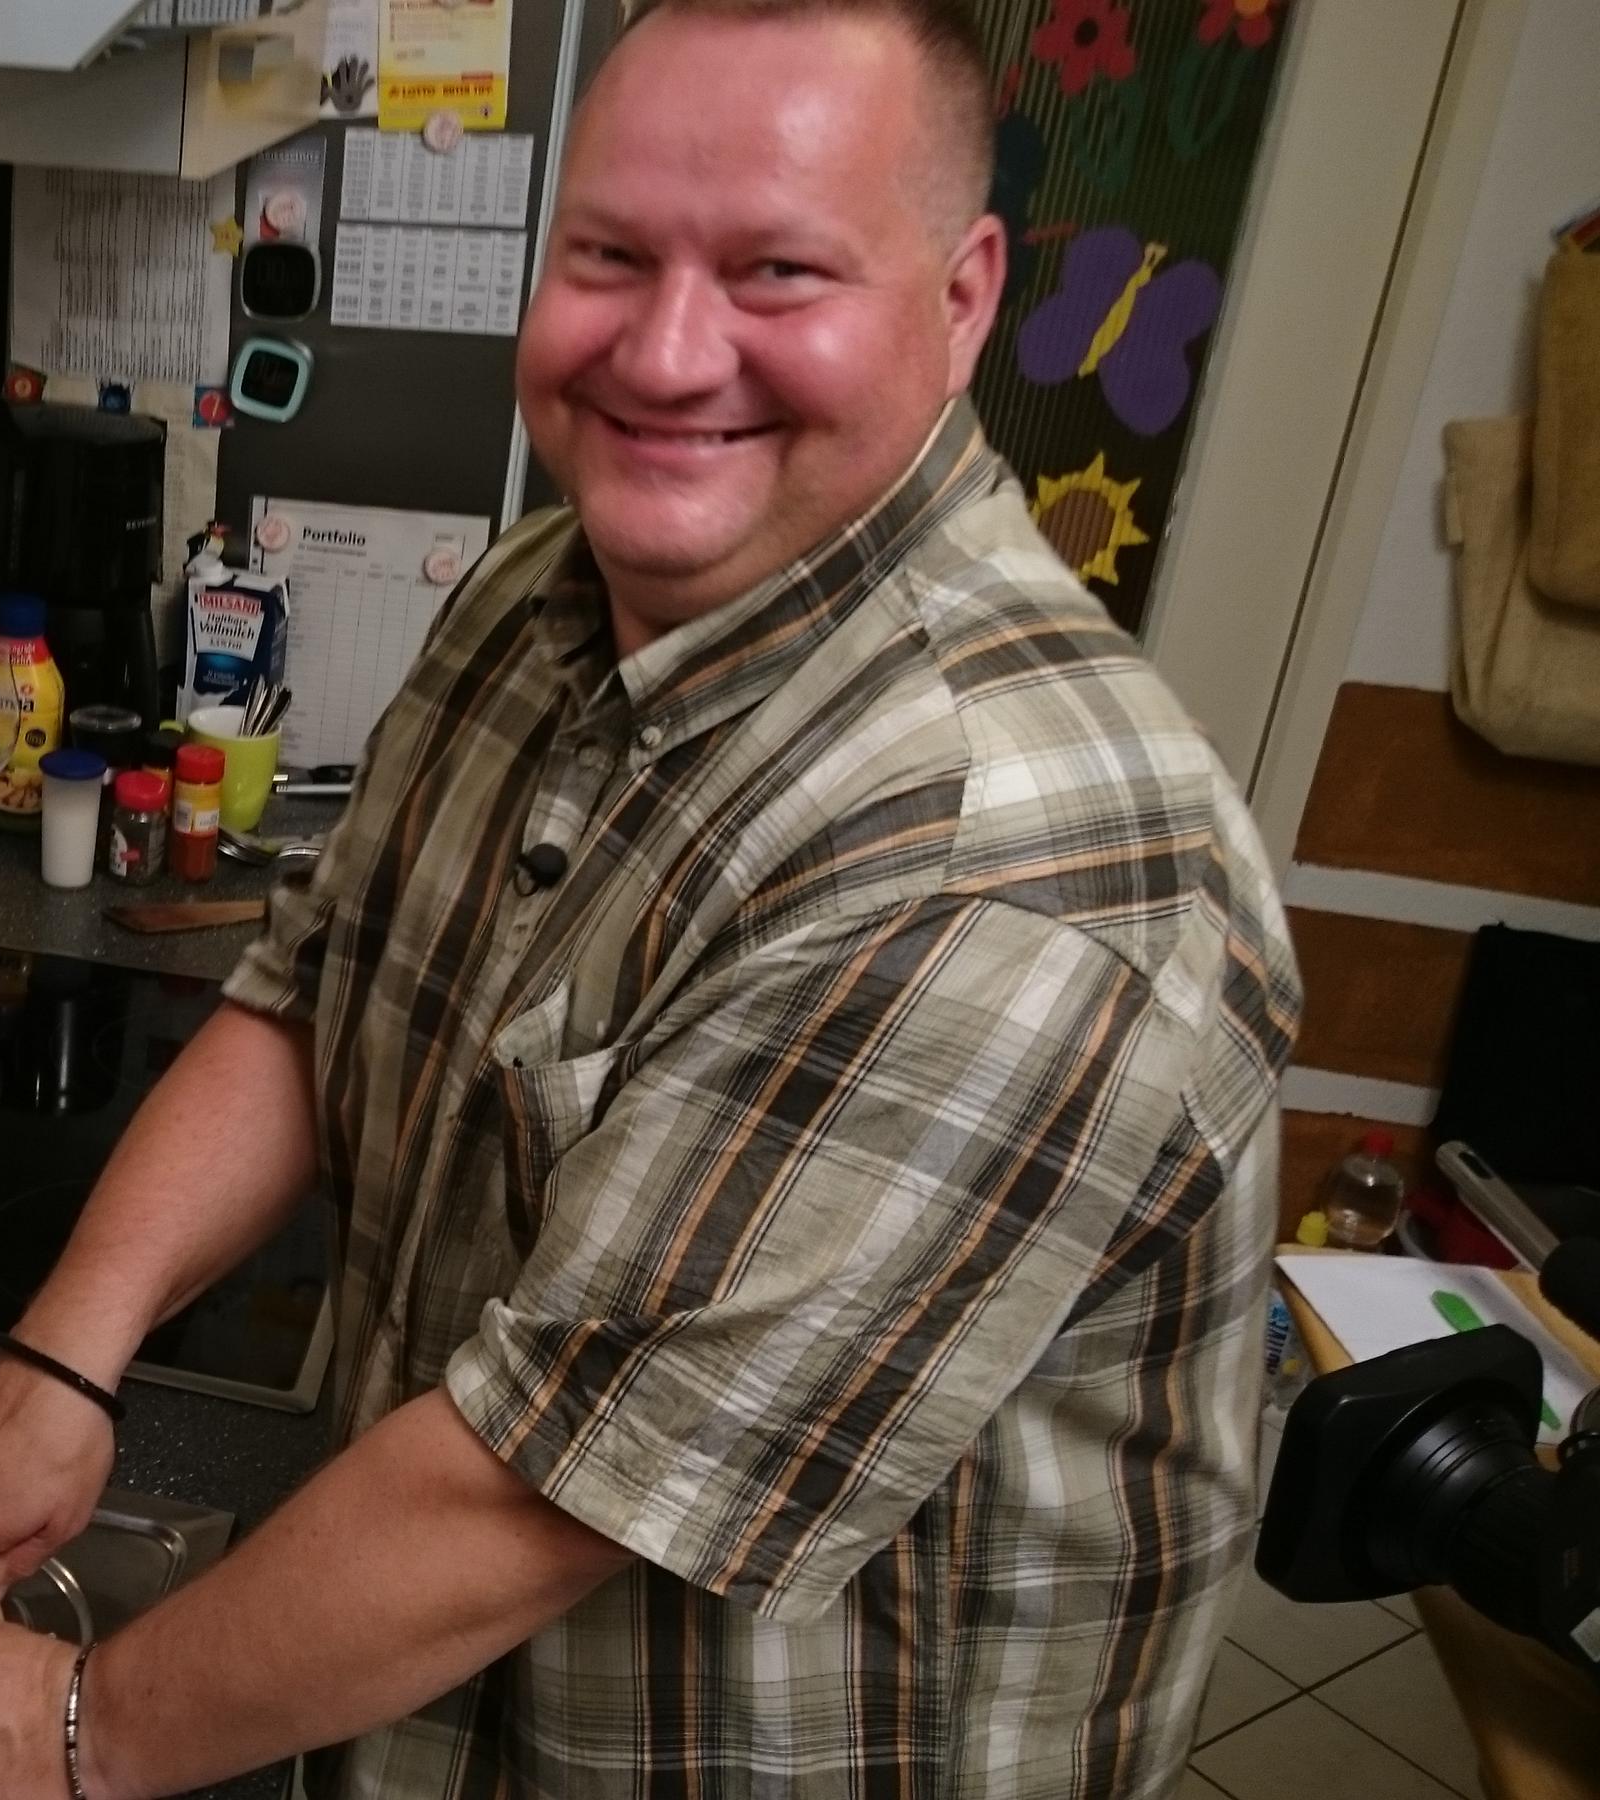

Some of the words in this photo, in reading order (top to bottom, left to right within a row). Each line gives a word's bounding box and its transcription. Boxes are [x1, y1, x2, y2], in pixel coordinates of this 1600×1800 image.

[302, 526, 366, 547] Portfolio
[201, 594, 261, 616] MILSANI
[207, 612, 249, 626] Haltbare
[200, 621, 255, 640] Vollmilch
